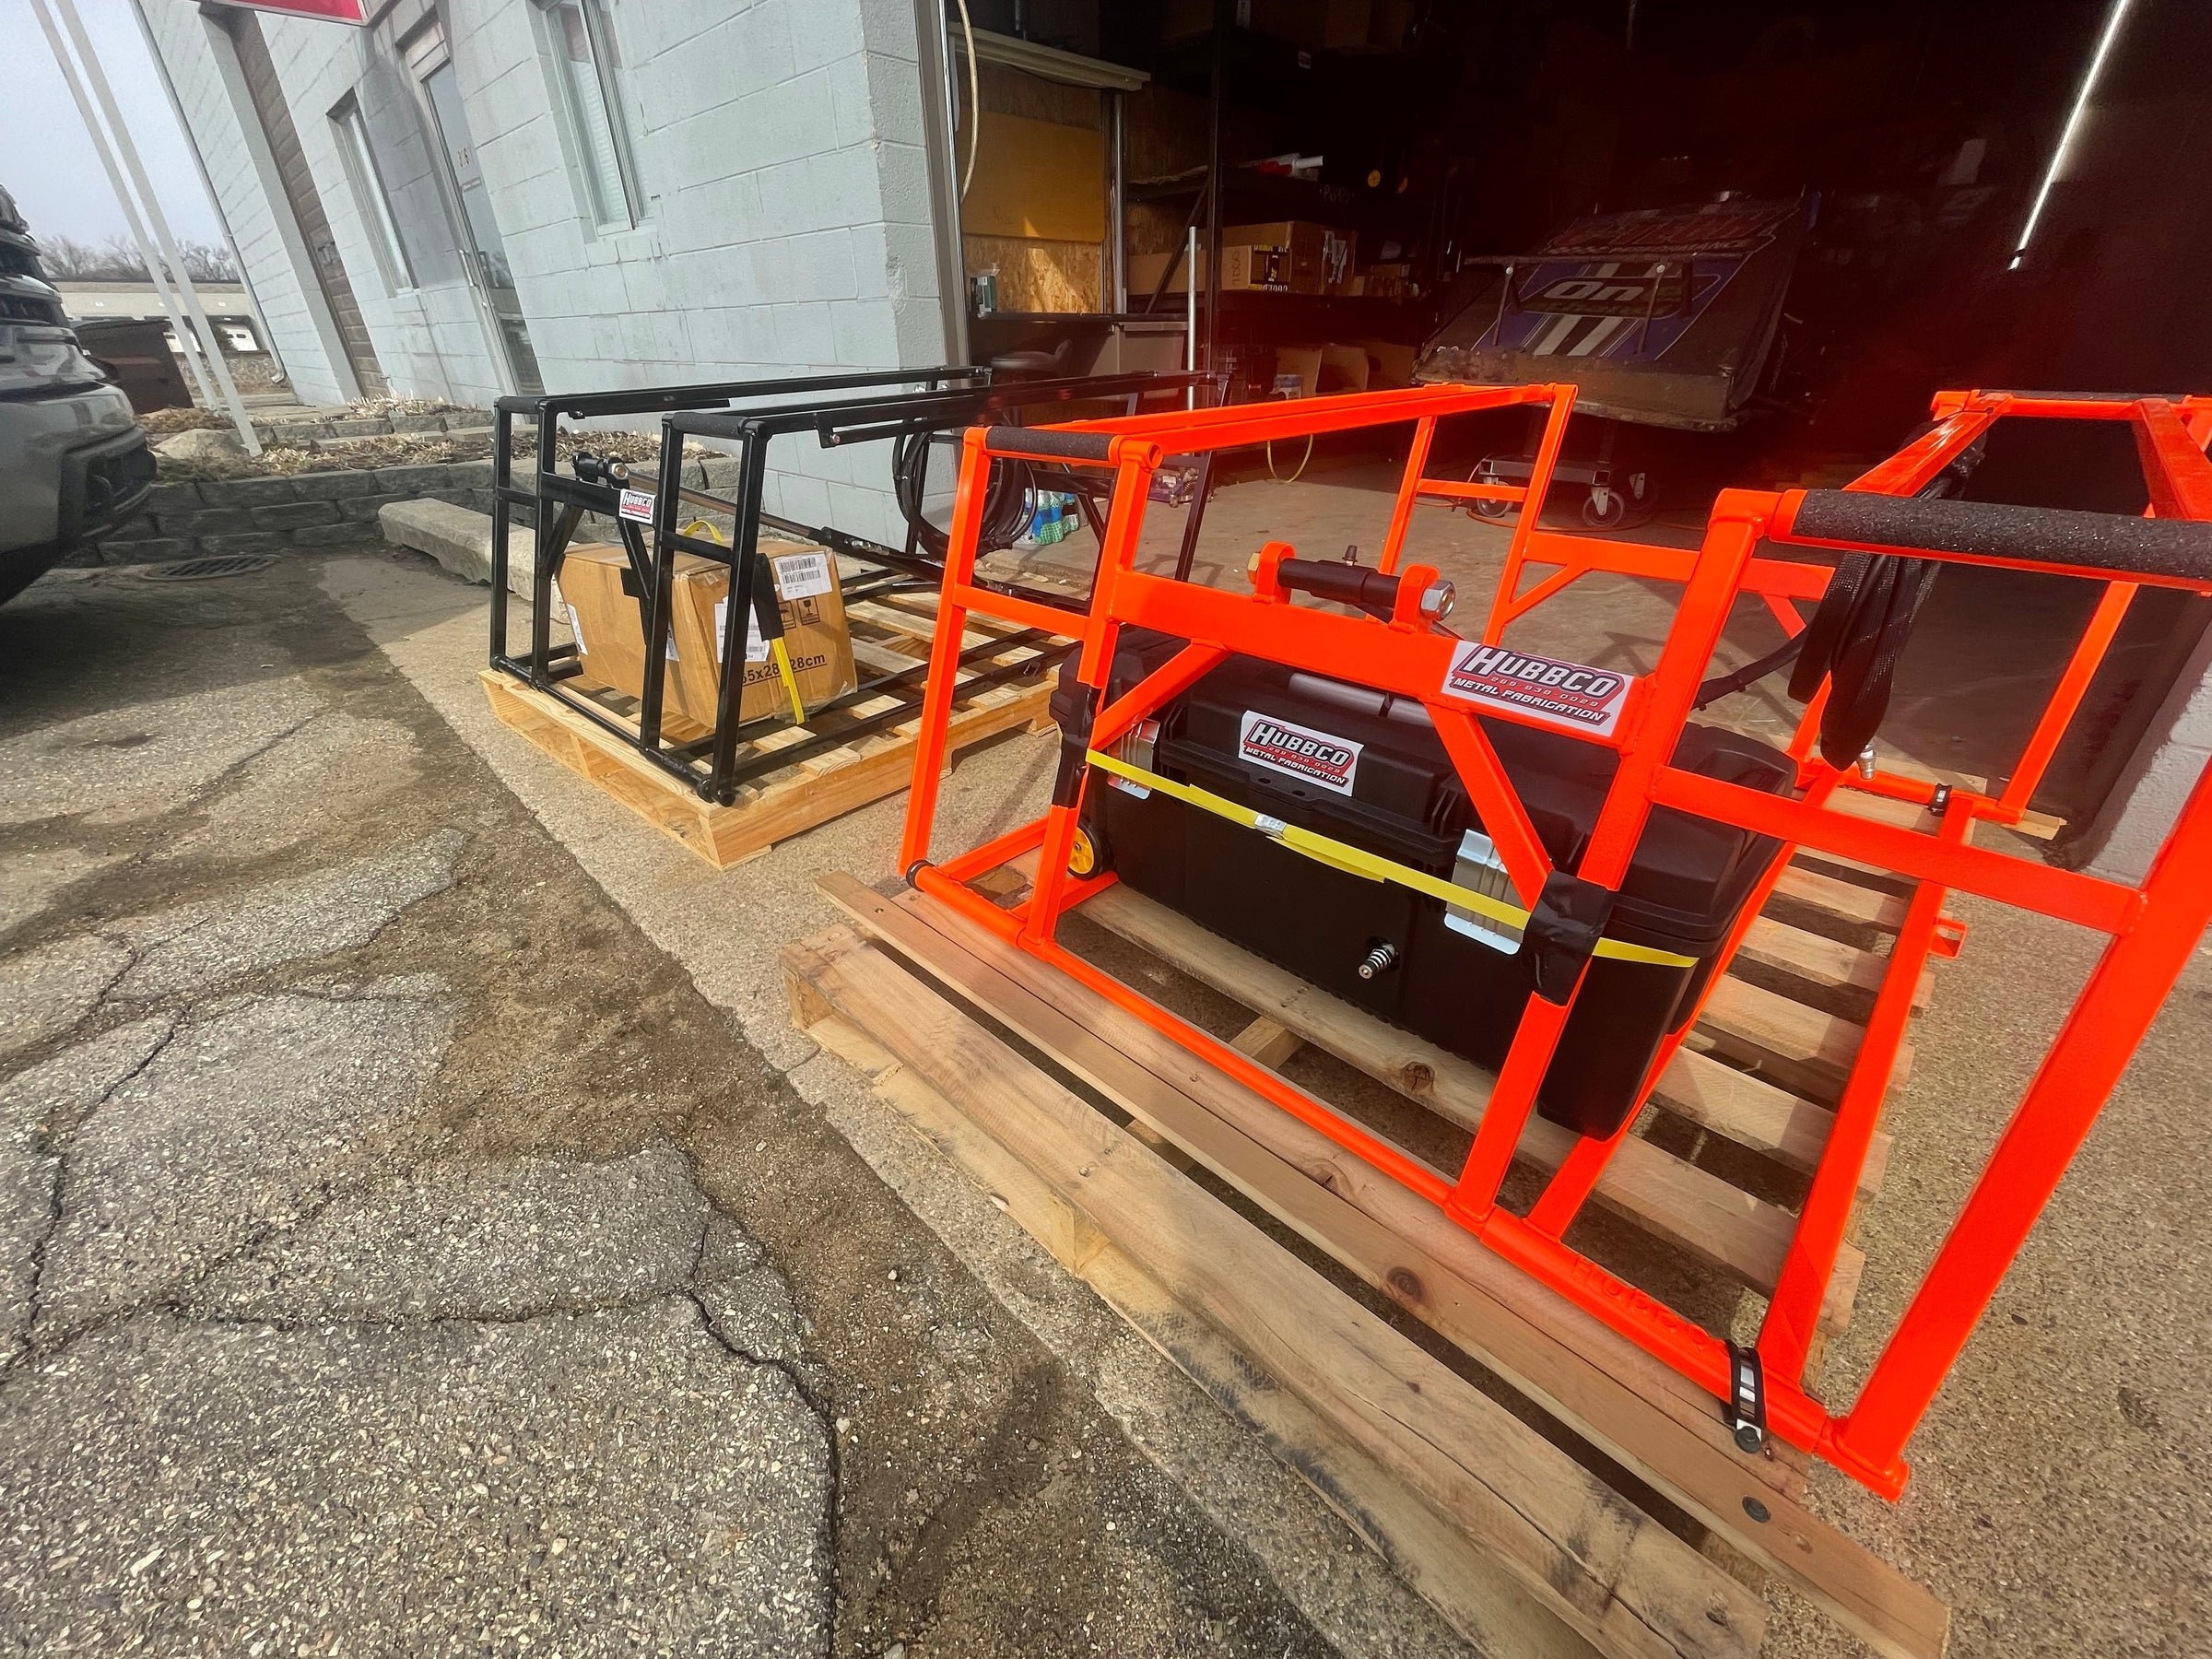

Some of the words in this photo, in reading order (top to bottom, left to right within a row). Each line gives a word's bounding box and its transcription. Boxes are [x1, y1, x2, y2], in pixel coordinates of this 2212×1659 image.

[623, 492, 653, 508] HUBBCO
[1463, 646, 1618, 697] HUBBCO
[1453, 677, 1500, 695] METAL
[1501, 689, 1605, 722] FABRICATION
[1245, 746, 1277, 761] METAL
[1277, 756, 1347, 785] FABRICATION
[1249, 723, 1350, 767] HUBBCO
